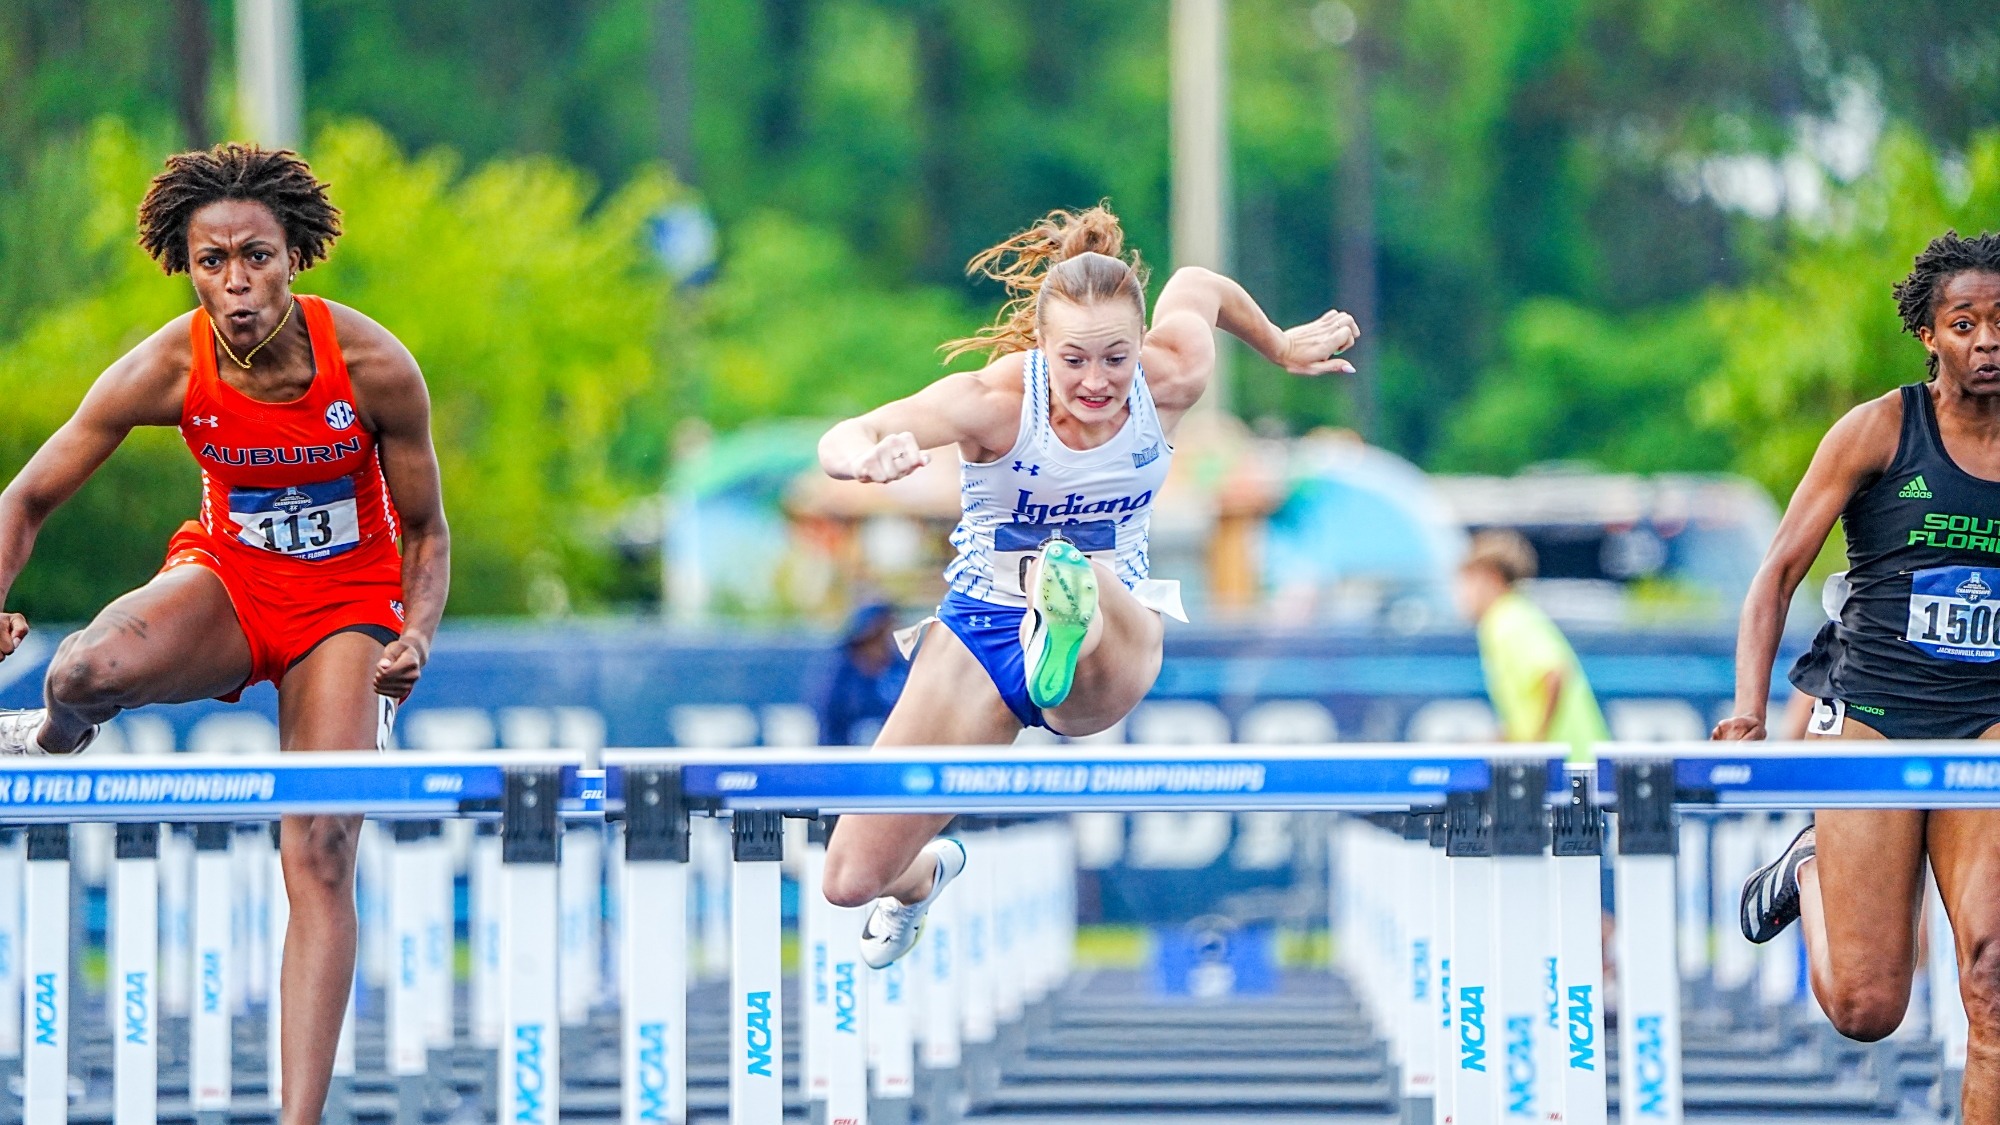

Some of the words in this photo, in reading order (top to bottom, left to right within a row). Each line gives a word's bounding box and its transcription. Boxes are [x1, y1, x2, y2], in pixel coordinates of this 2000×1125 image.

[326, 401, 355, 428] SEC
[201, 436, 361, 466] AUBURN
[1899, 489, 1932, 499] adidas
[259, 510, 332, 552] 113
[1907, 530, 2000, 555] FLORI
[1924, 513, 2000, 536] SOU
[33, 774, 92, 802] FIELD
[95, 772, 275, 801] CHAMPIONSHIPS
[580, 789, 605, 800] GIL
[940, 765, 1010, 793] TRACK
[1031, 765, 1089, 792] FIELD
[1091, 763, 1265, 792] CHAMPIONSHIPS
[1944, 761, 2000, 789] TRAC
[36, 973, 57, 1046] NCAA
[126, 972, 148, 1046] NCAA
[836, 962, 856, 1035] NCAA
[747, 991, 772, 1077] NCAA
[1460, 986, 1486, 1073] NCAA
[1568, 984, 1594, 1071] NCAA
[515, 1024, 545, 1125] NCAA
[642, 1023, 670, 1125] NCAA
[1507, 1015, 1536, 1120] NCAA
[1636, 1015, 1667, 1120] NCAA
